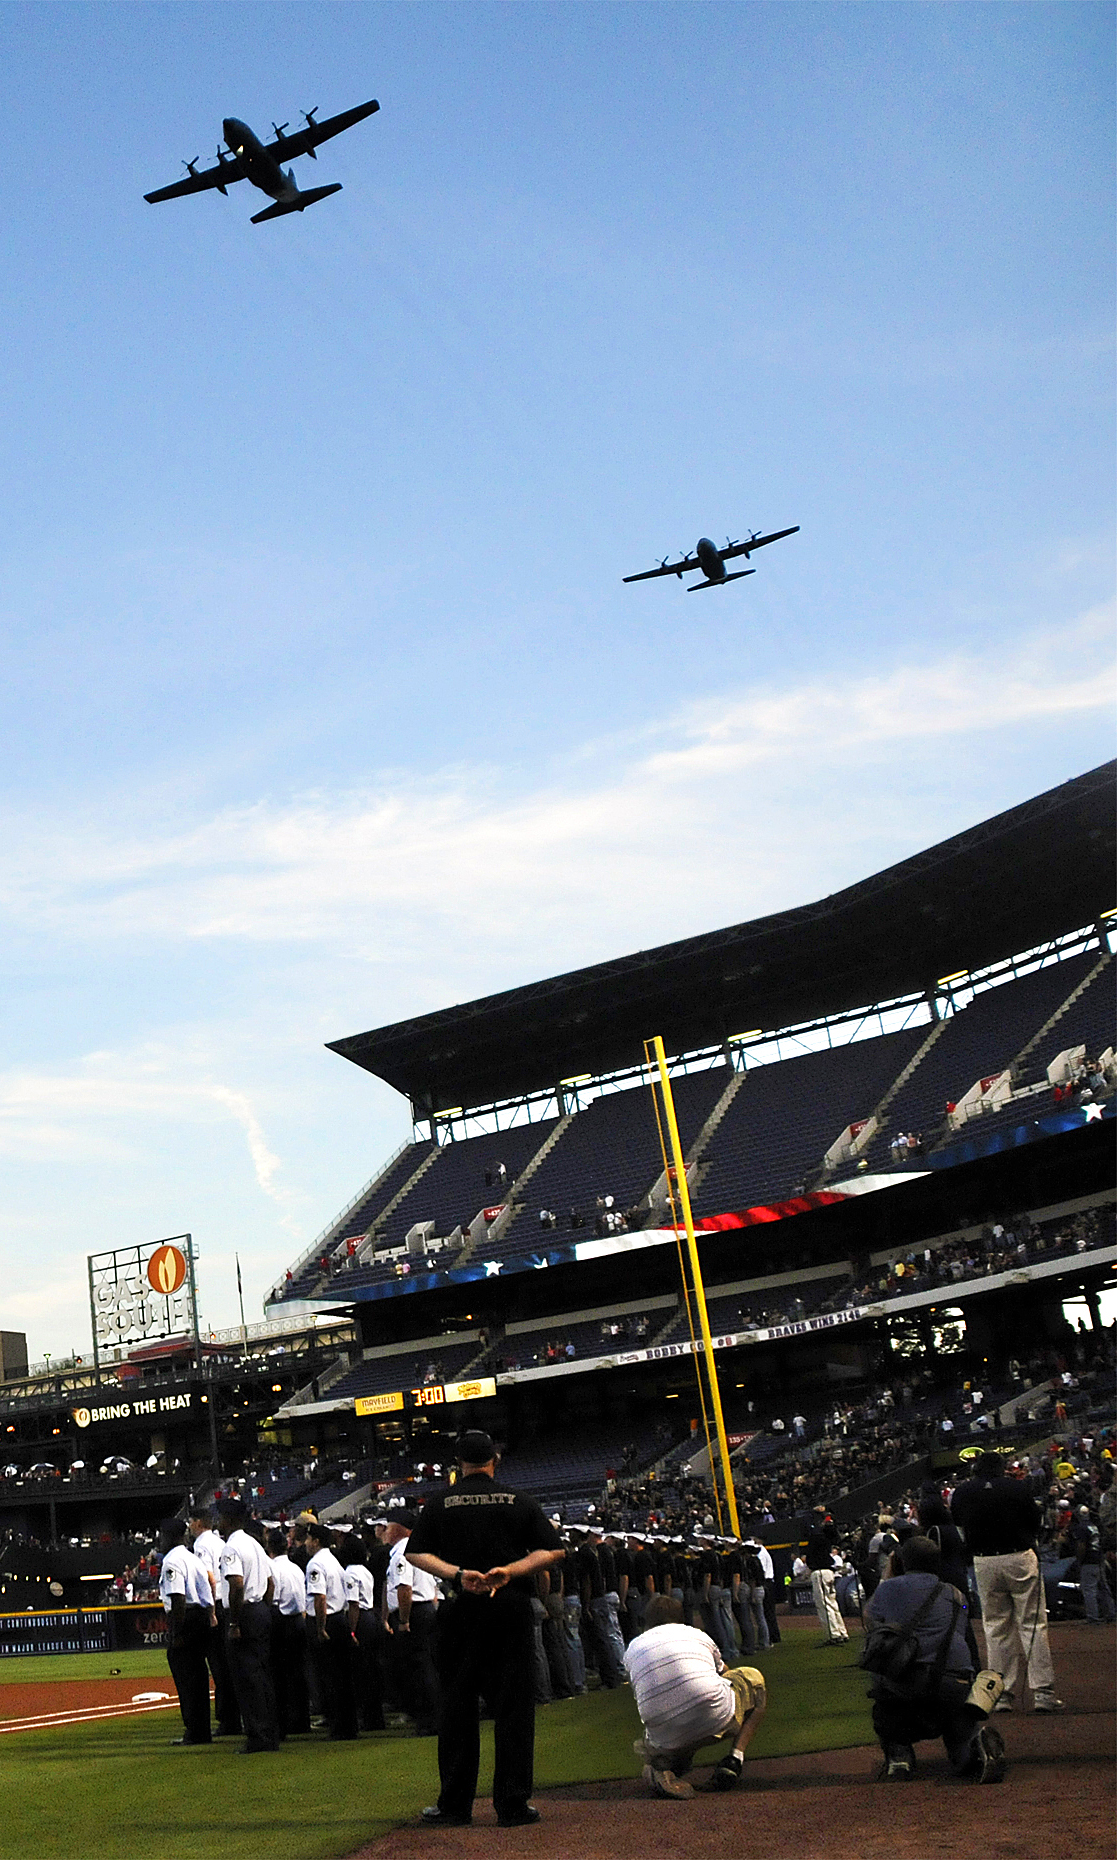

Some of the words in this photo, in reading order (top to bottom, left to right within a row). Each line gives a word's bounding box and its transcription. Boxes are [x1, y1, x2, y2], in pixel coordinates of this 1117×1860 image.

[93, 1273, 149, 1308] GAS
[96, 1294, 190, 1340] SOUTH
[767, 1322, 807, 1339] BRAVES
[809, 1315, 835, 1330] WINS
[91, 1403, 131, 1422] BRING
[133, 1399, 157, 1416] THE
[159, 1393, 192, 1412] HEAT
[444, 1492, 517, 1509] SECURITY
[1, 1644, 10, 1654] IN
[12, 1642, 34, 1653] MAJOR
